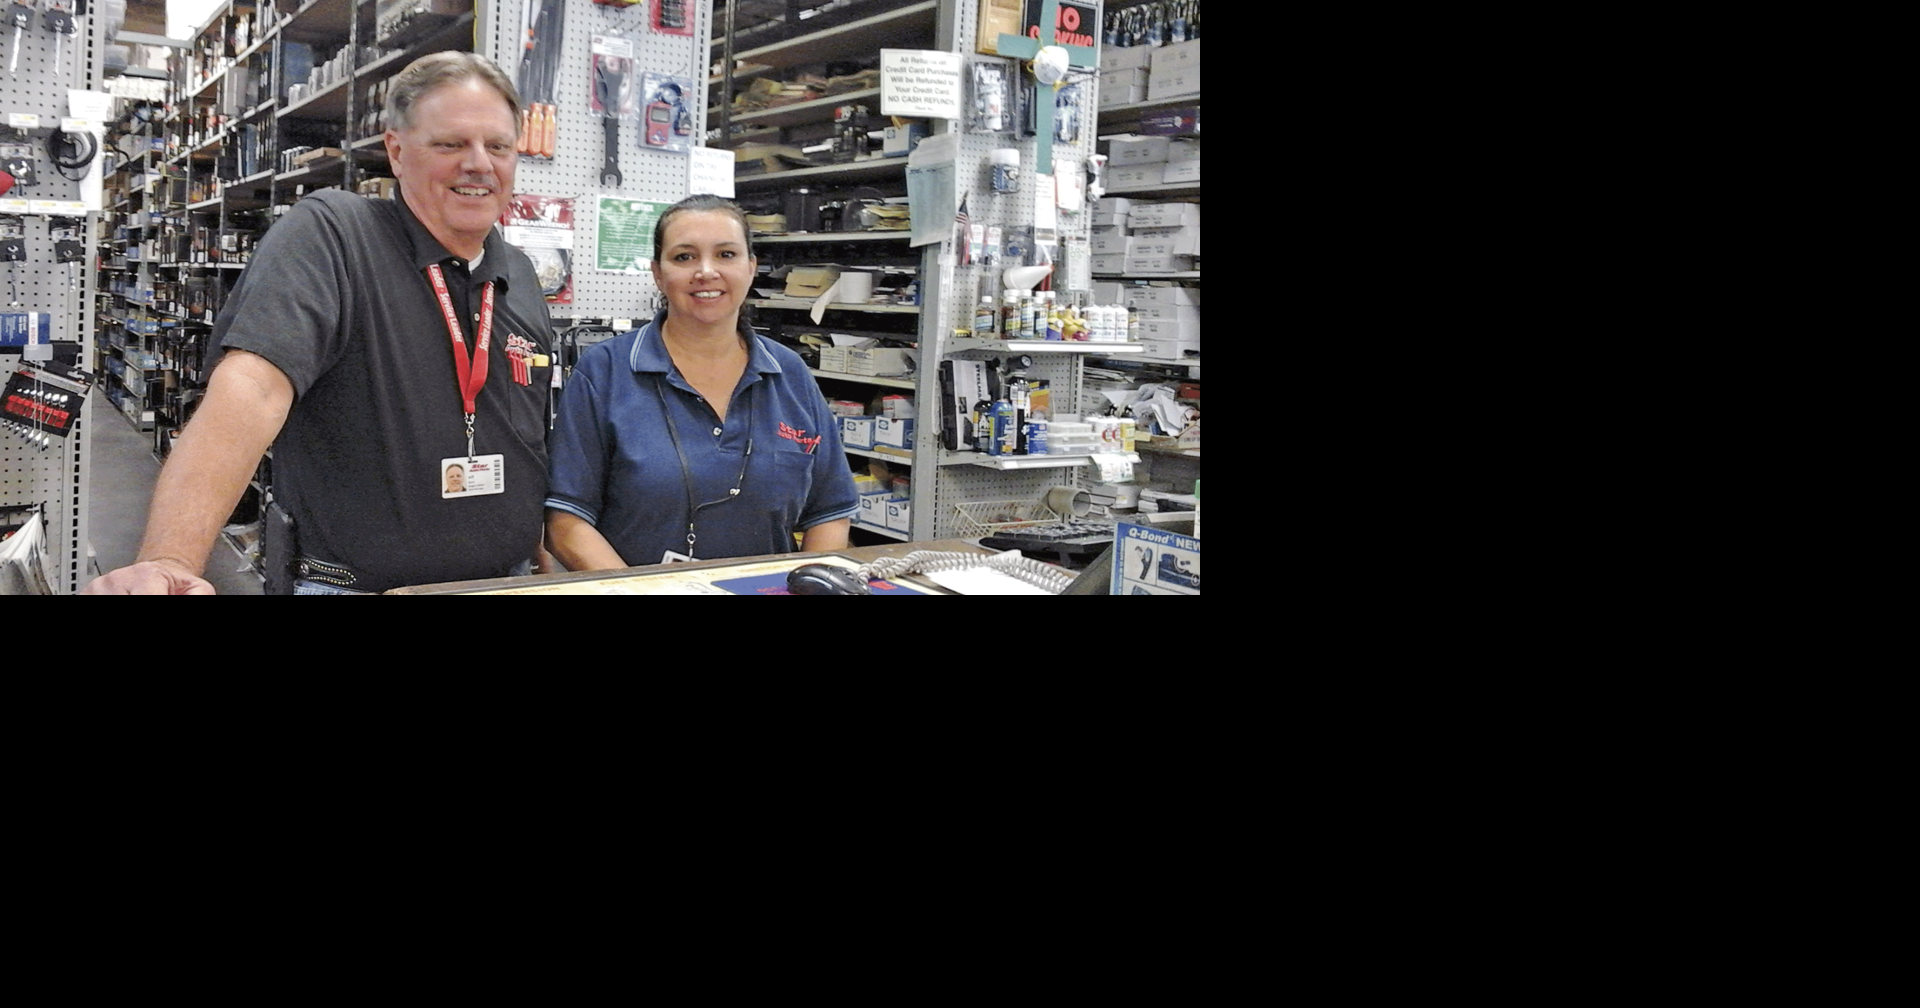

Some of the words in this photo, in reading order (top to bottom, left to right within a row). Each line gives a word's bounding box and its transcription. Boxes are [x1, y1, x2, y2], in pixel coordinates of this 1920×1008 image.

[1055, 5, 1080, 31] O
[900, 56, 909, 64] All
[908, 66, 925, 74] Card
[926, 68, 959, 77] Purchases
[916, 76, 947, 85] Refunded
[912, 86, 933, 94] Credit
[888, 95, 899, 103] NO
[901, 95, 922, 104] CASH
[429, 263, 444, 288] Leader
[440, 292, 456, 318] Service
[449, 317, 463, 342] Leader
[482, 307, 493, 330] Leader
[478, 328, 492, 351] Service
[975, 364, 983, 398] STEELMA
[779, 421, 806, 437] Star
[1129, 527, 1169, 544] Q-Bond
